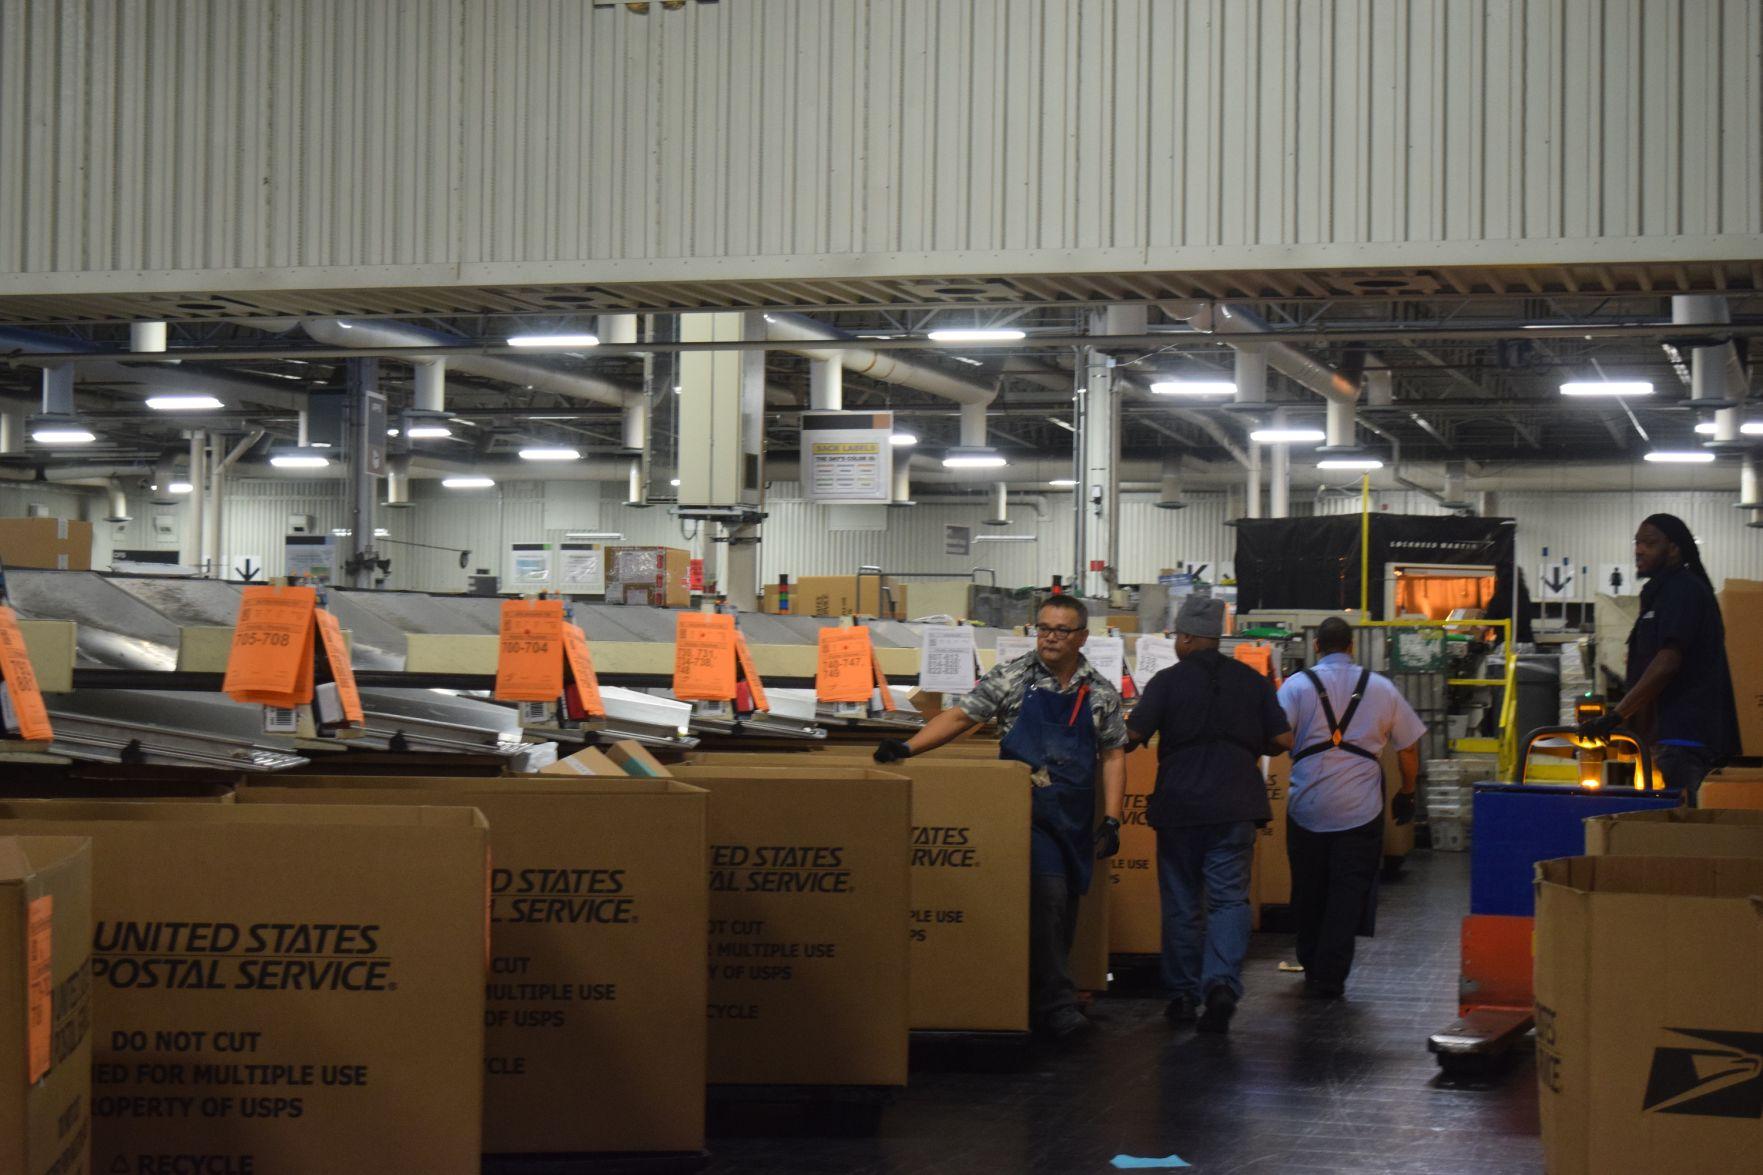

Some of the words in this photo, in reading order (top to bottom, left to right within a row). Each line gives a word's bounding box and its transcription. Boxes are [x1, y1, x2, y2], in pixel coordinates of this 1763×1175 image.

[752, 846, 844, 867] STATES
[1127, 859, 1150, 869] USE
[516, 869, 625, 893] STATES
[936, 910, 964, 923] USE
[92, 920, 239, 953] UNITED
[244, 923, 380, 954] STATES
[731, 920, 764, 936] CUT
[716, 943, 800, 958] MULTIPLE
[804, 944, 835, 958] USE
[92, 957, 226, 989] POSTAL
[492, 956, 530, 974] CUT
[723, 965, 745, 980] OF
[749, 965, 792, 980] USPS
[579, 984, 616, 1001] USE
[514, 1010, 565, 1027] USPS
[112, 1030, 147, 1052] DO
[155, 1031, 206, 1052] NOT
[213, 1031, 262, 1052] CUT
[137, 1064, 185, 1085] FOR
[194, 1064, 315, 1086] MULTIPLE
[322, 1065, 369, 1086] USE
[201, 1097, 235, 1118] OF
[241, 1097, 303, 1118] USPS
[138, 1154, 255, 1175] RECYCLE
